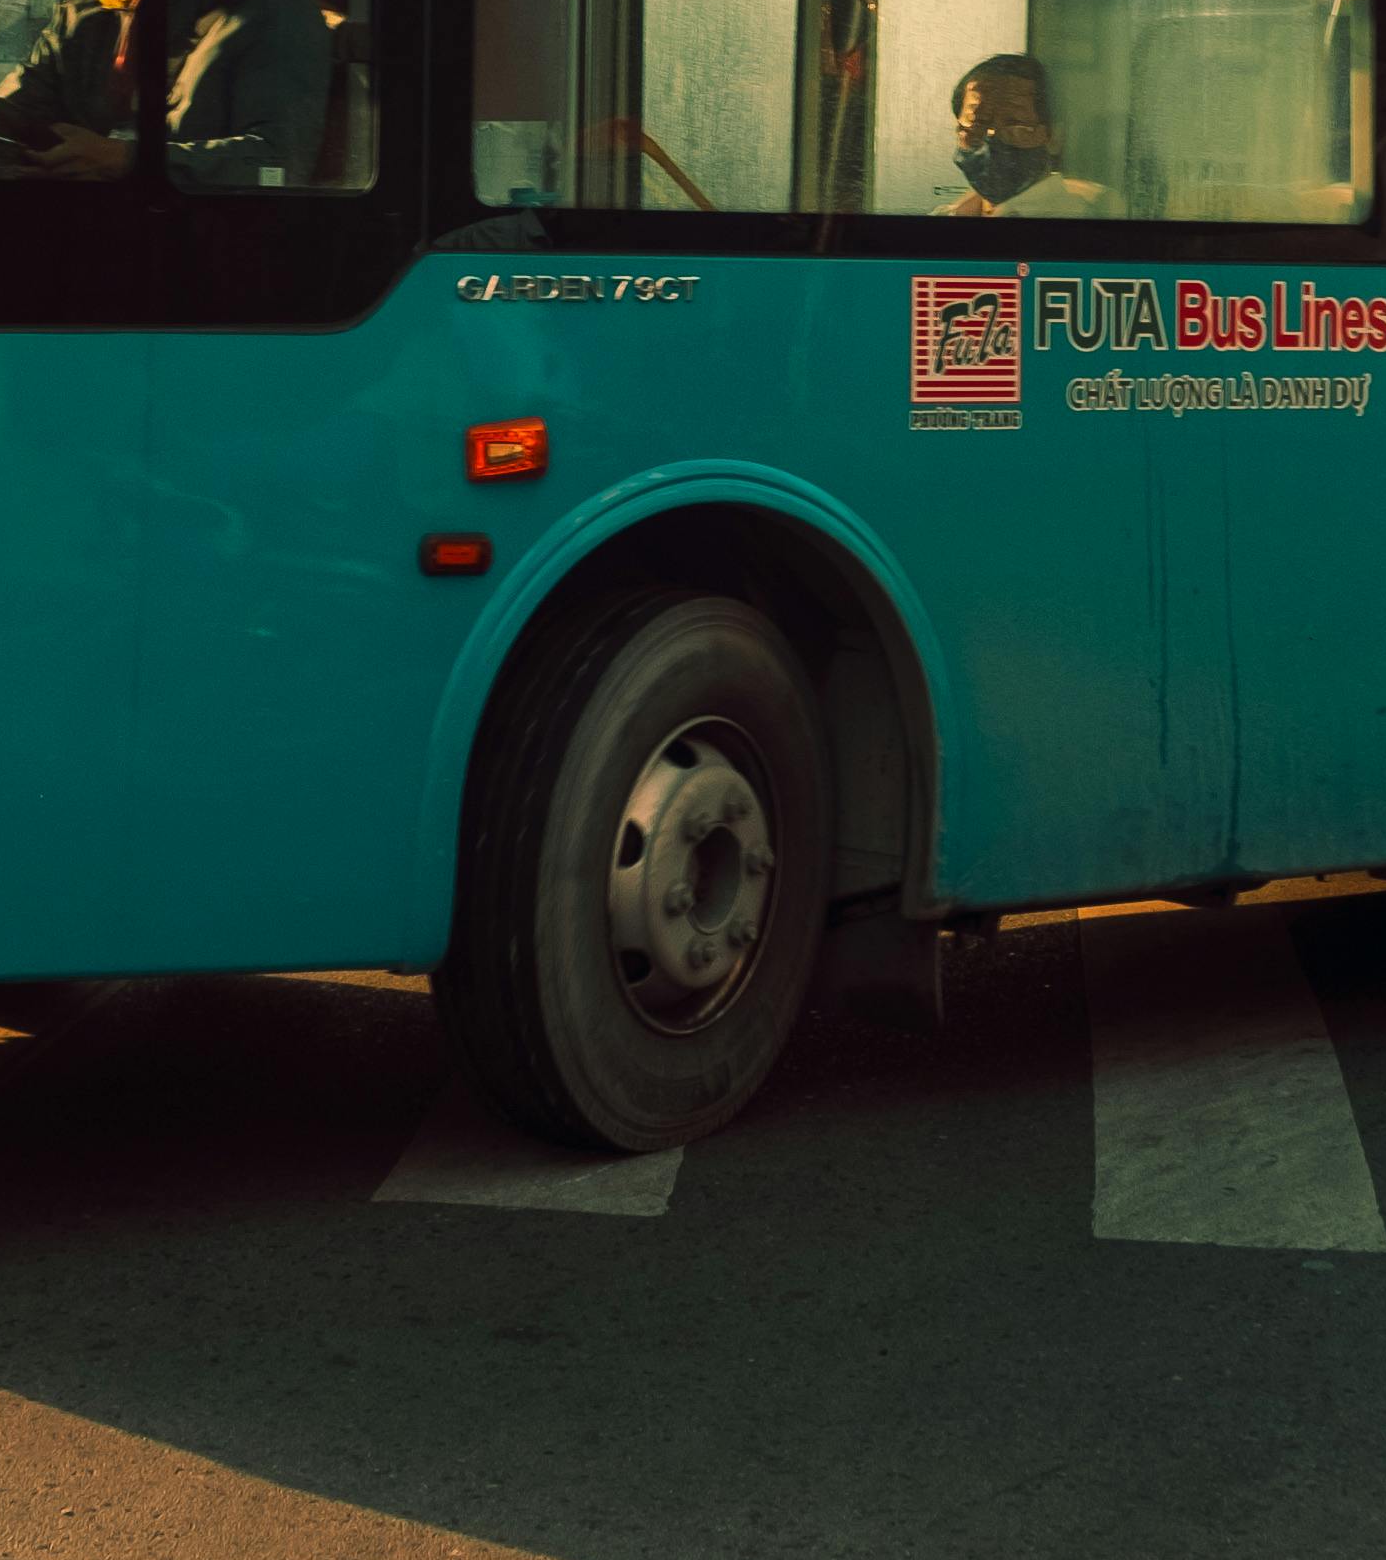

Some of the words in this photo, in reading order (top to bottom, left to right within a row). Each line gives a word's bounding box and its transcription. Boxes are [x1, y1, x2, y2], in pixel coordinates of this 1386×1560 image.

[456, 274, 606, 301] GARDEN
[611, 274, 702, 301] 79CT
[1034, 277, 1170, 352] FUTA
[1175, 279, 1266, 352] Bus
[1066, 367, 1134, 412] CHẤT
[1135, 373, 1224, 418] LƯỢNG
[1225, 371, 1259, 410] LÀ
[1261, 376, 1331, 410] DANH
[1331, 373, 1372, 417] DỰ
